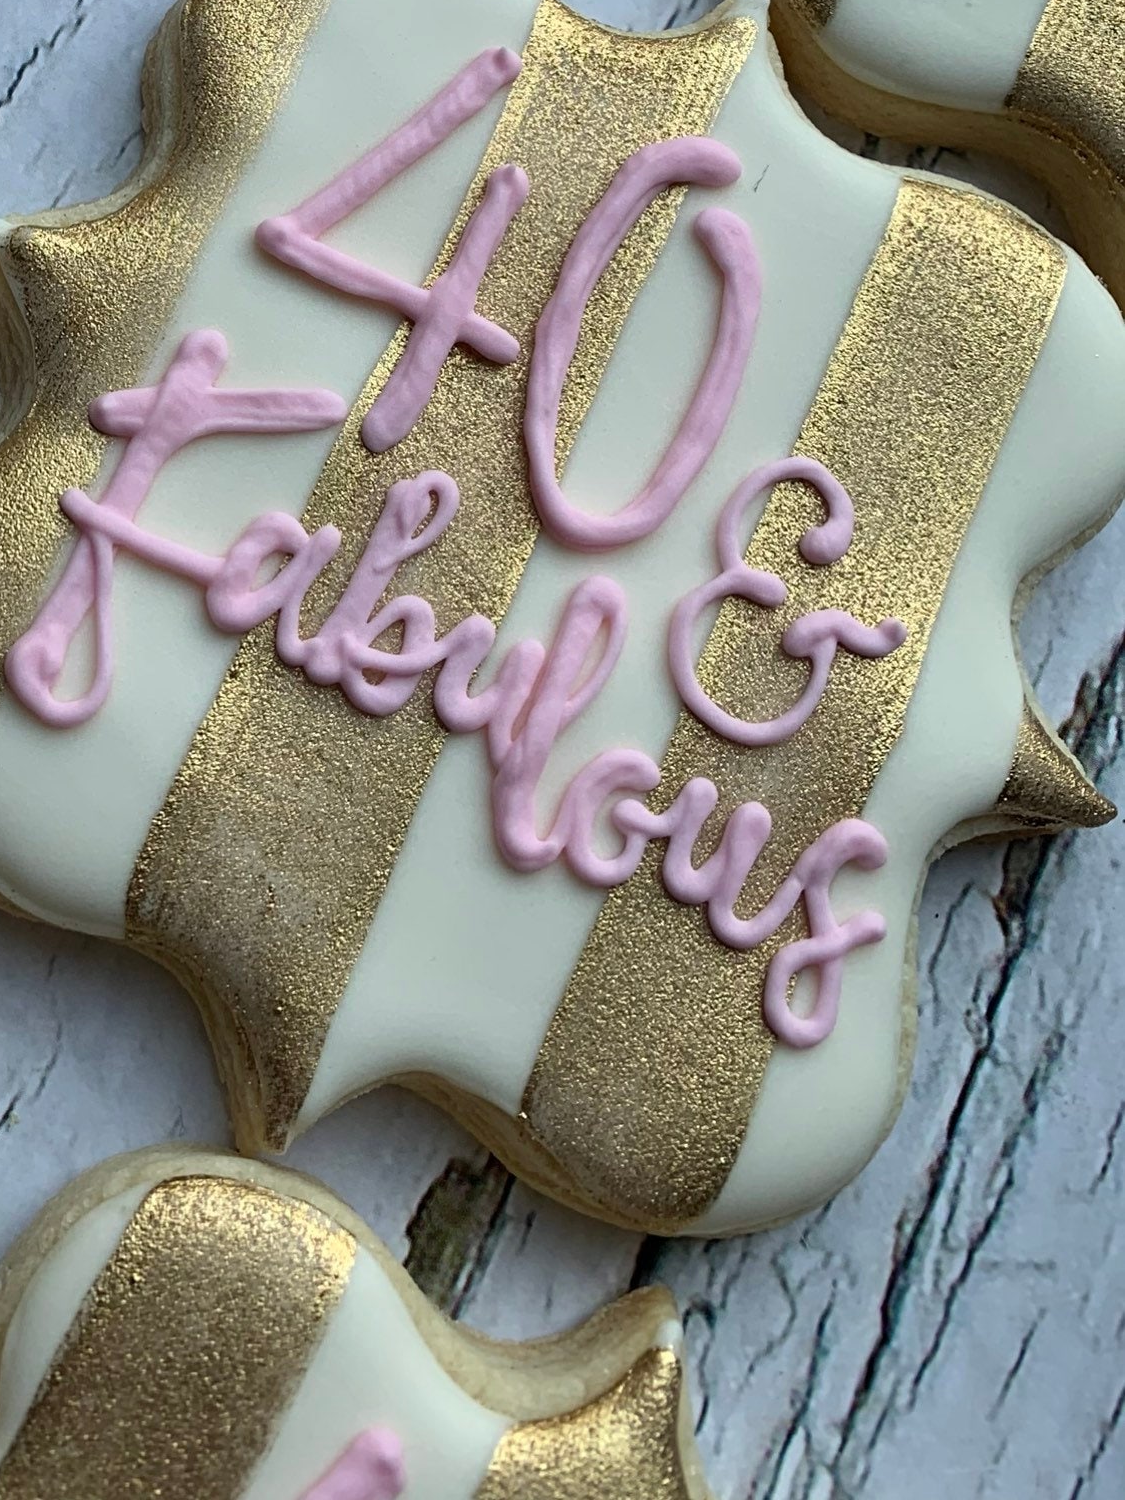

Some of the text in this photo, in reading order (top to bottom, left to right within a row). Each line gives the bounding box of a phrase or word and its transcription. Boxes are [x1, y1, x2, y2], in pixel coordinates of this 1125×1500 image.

[5, 328, 889, 1049] Fabulous
[253, 46, 906, 747] 40 &
